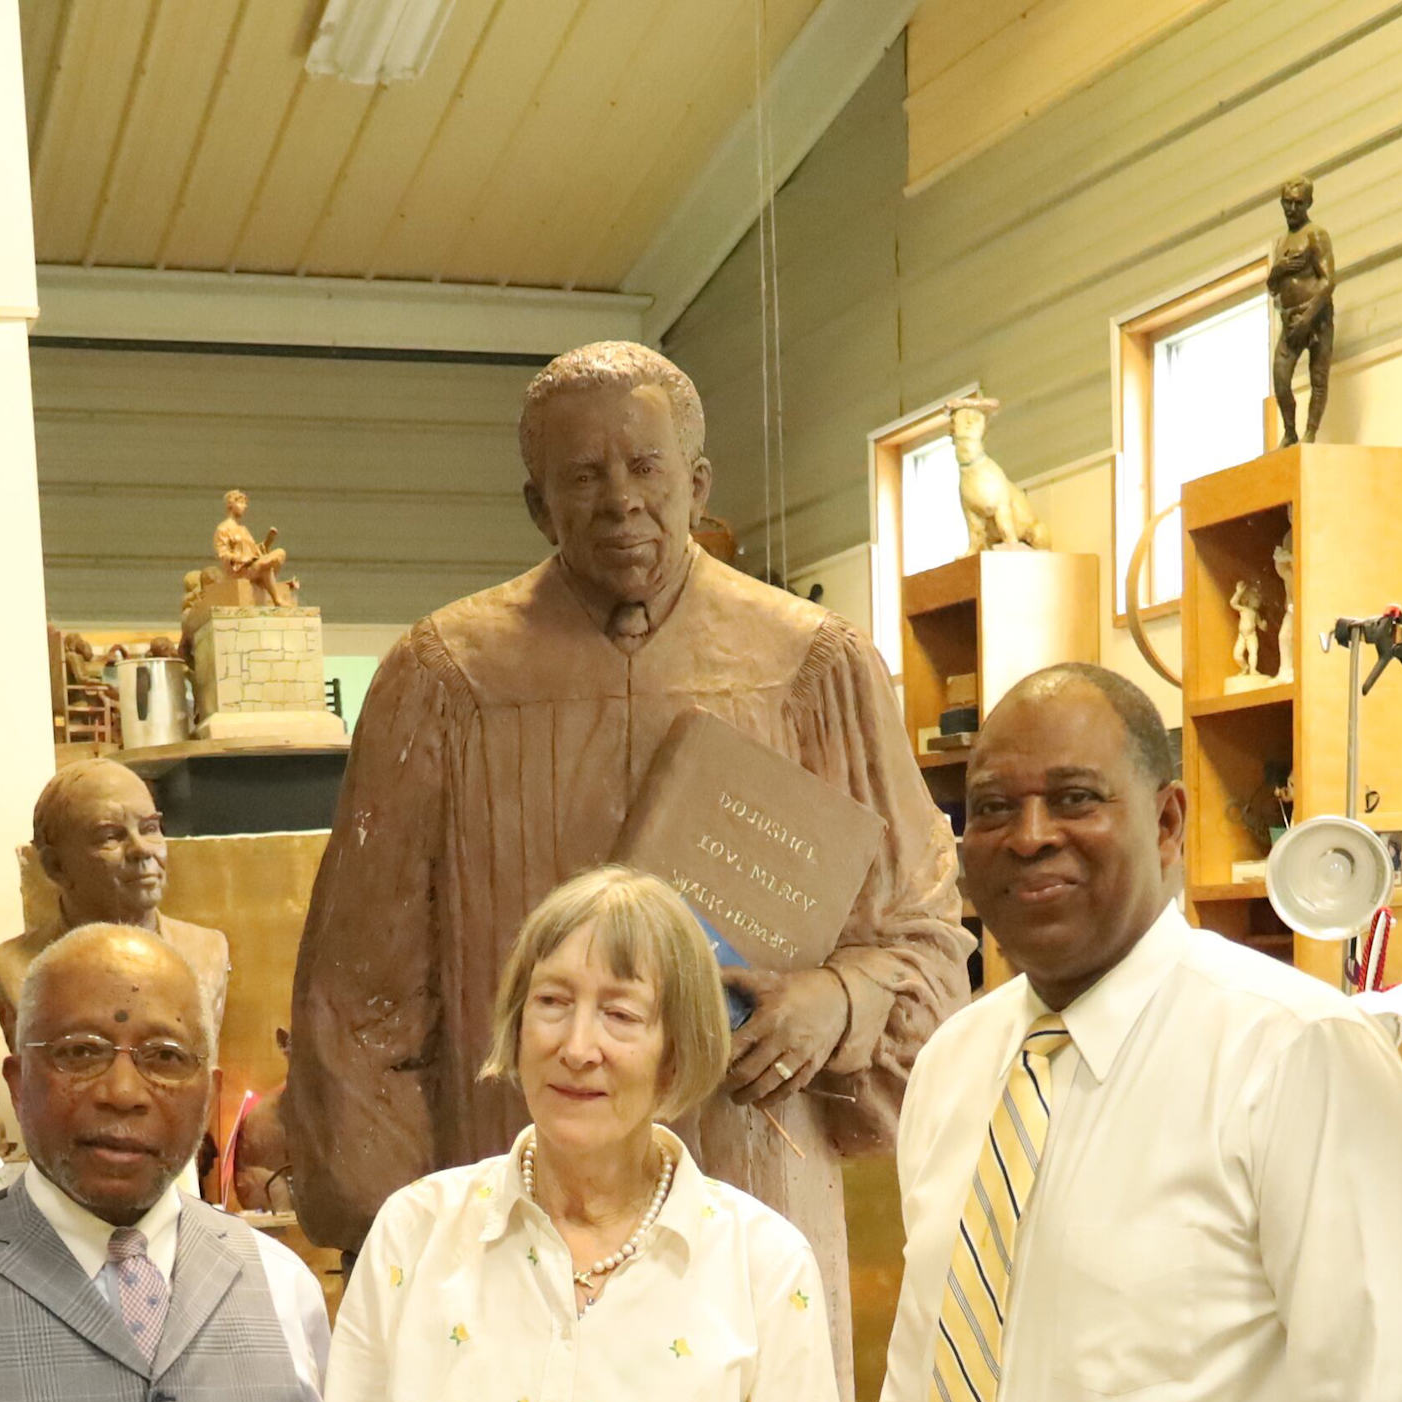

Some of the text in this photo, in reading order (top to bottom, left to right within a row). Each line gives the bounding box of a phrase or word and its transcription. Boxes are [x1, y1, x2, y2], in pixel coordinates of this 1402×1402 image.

[718, 791, 818, 865] DO JUSTICE
[671, 868, 724, 915] WALK
[697, 834, 818, 912] LOVE MERCY
